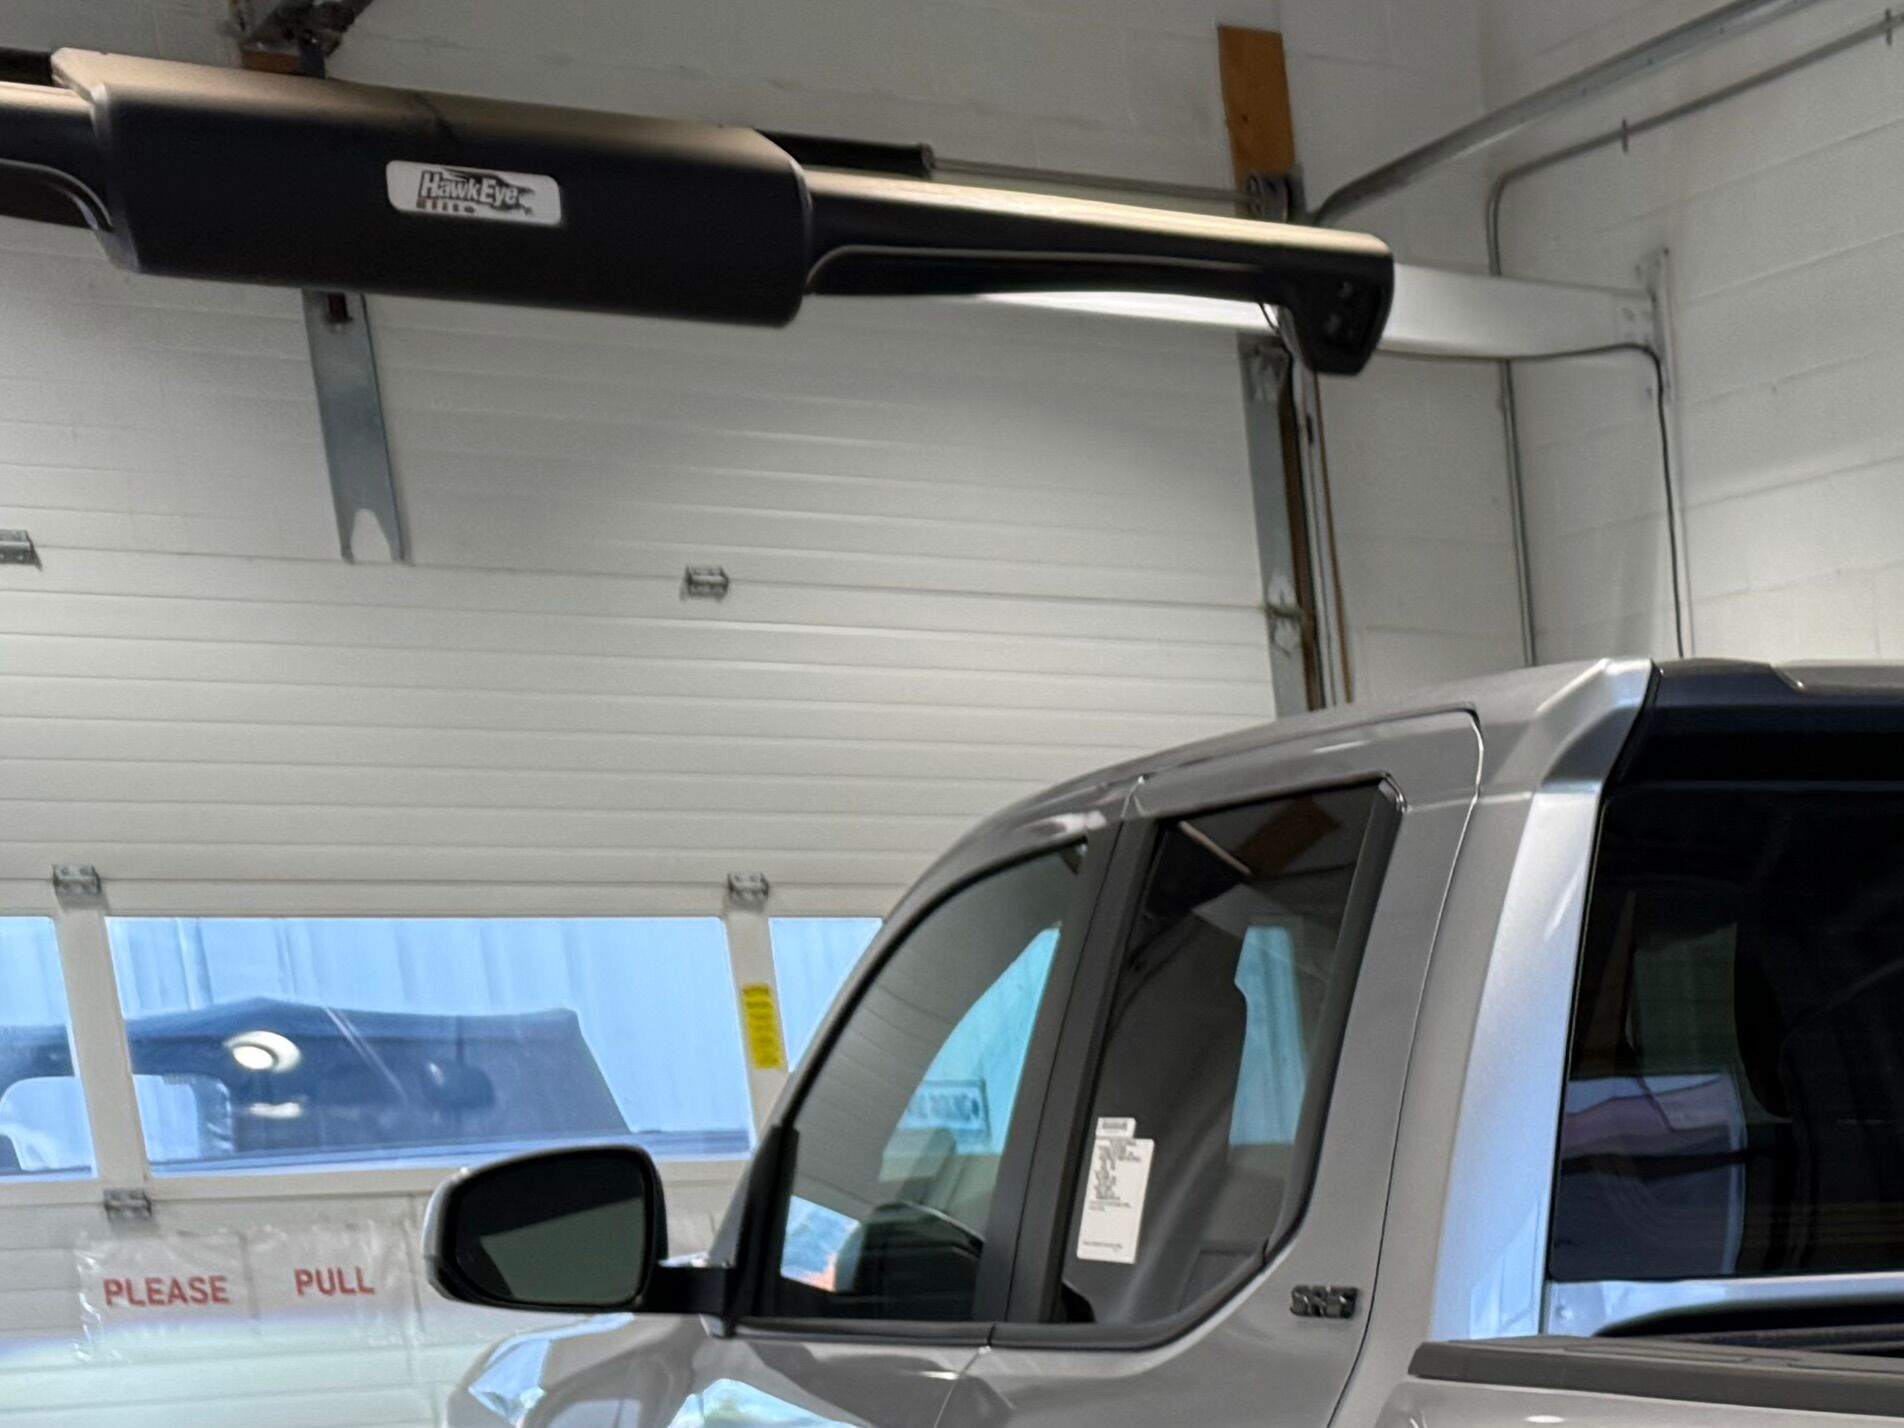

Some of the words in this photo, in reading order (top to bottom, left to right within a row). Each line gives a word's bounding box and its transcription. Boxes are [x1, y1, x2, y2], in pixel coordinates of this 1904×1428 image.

[419, 169, 521, 206] HawkEye
[103, 1275, 231, 1306] PLEASE
[294, 1266, 375, 1296] PULL
